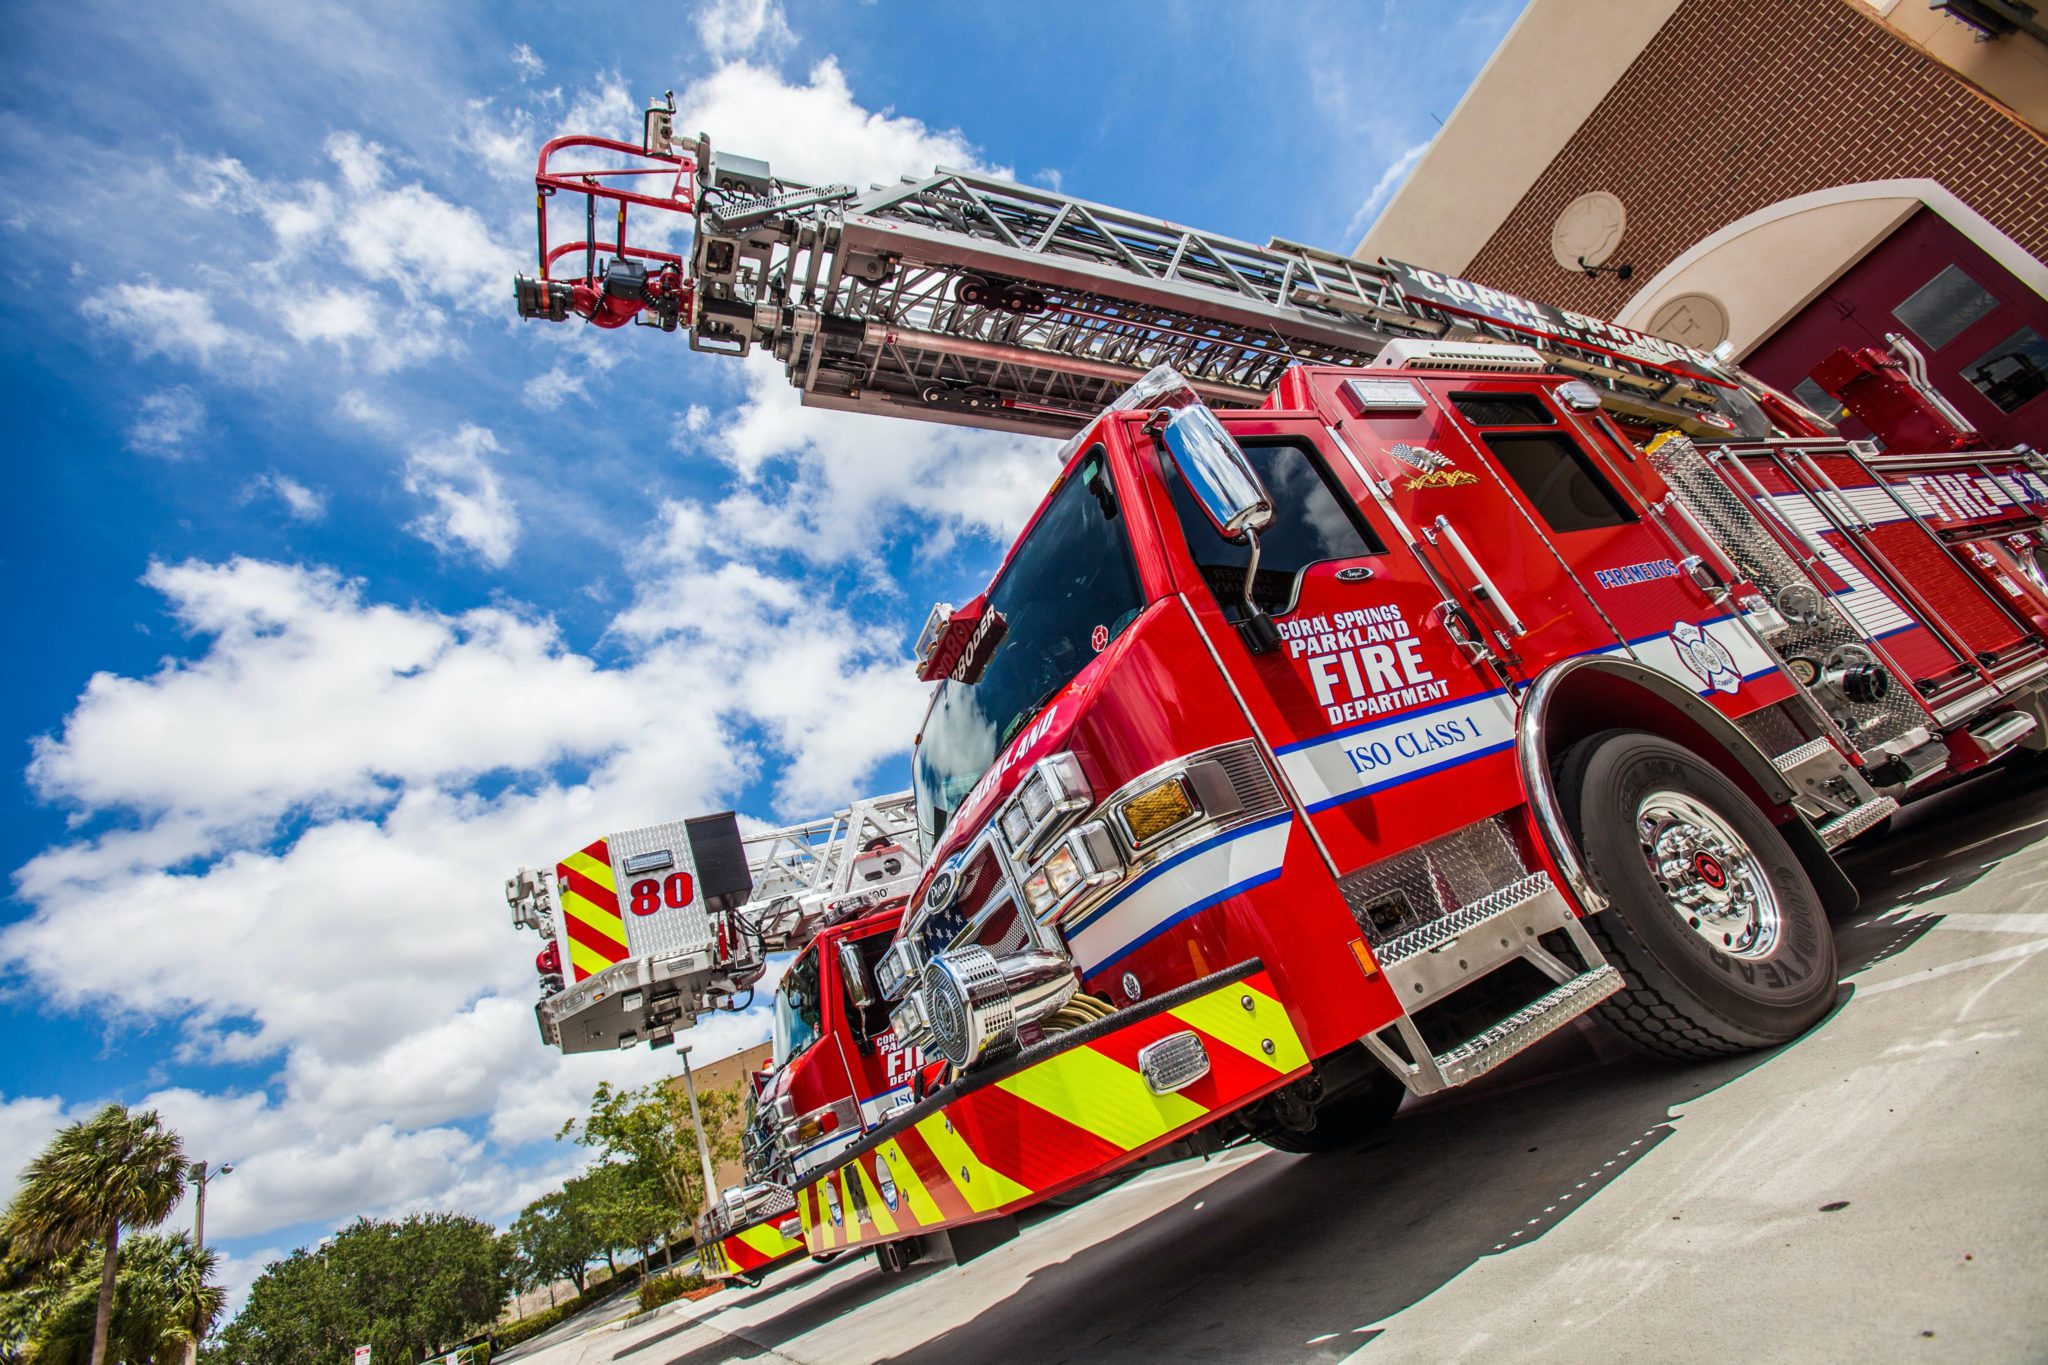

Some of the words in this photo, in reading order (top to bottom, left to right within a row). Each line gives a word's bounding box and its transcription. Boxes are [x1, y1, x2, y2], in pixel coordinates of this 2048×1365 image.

[1417, 269, 1549, 321] CORAL
[1560, 311, 1713, 367] SPRINGS
[1516, 314, 1581, 341] LADDER
[1907, 473, 2002, 522] FIRE
[1594, 559, 1680, 590] PARAMEDICS
[1277, 615, 1333, 641] CORAL
[1334, 604, 1402, 630] SPRINGS
[1289, 620, 1409, 659] PARKLAND
[1307, 637, 1434, 707] FIRE
[1327, 679, 1449, 725] DEPARTMENT
[1345, 742, 1392, 774] ISO
[1394, 721, 1466, 758] CLASS
[1466, 716, 1482, 738] 1
[630, 871, 694, 916] 80
[877, 1033, 897, 1047] COR
